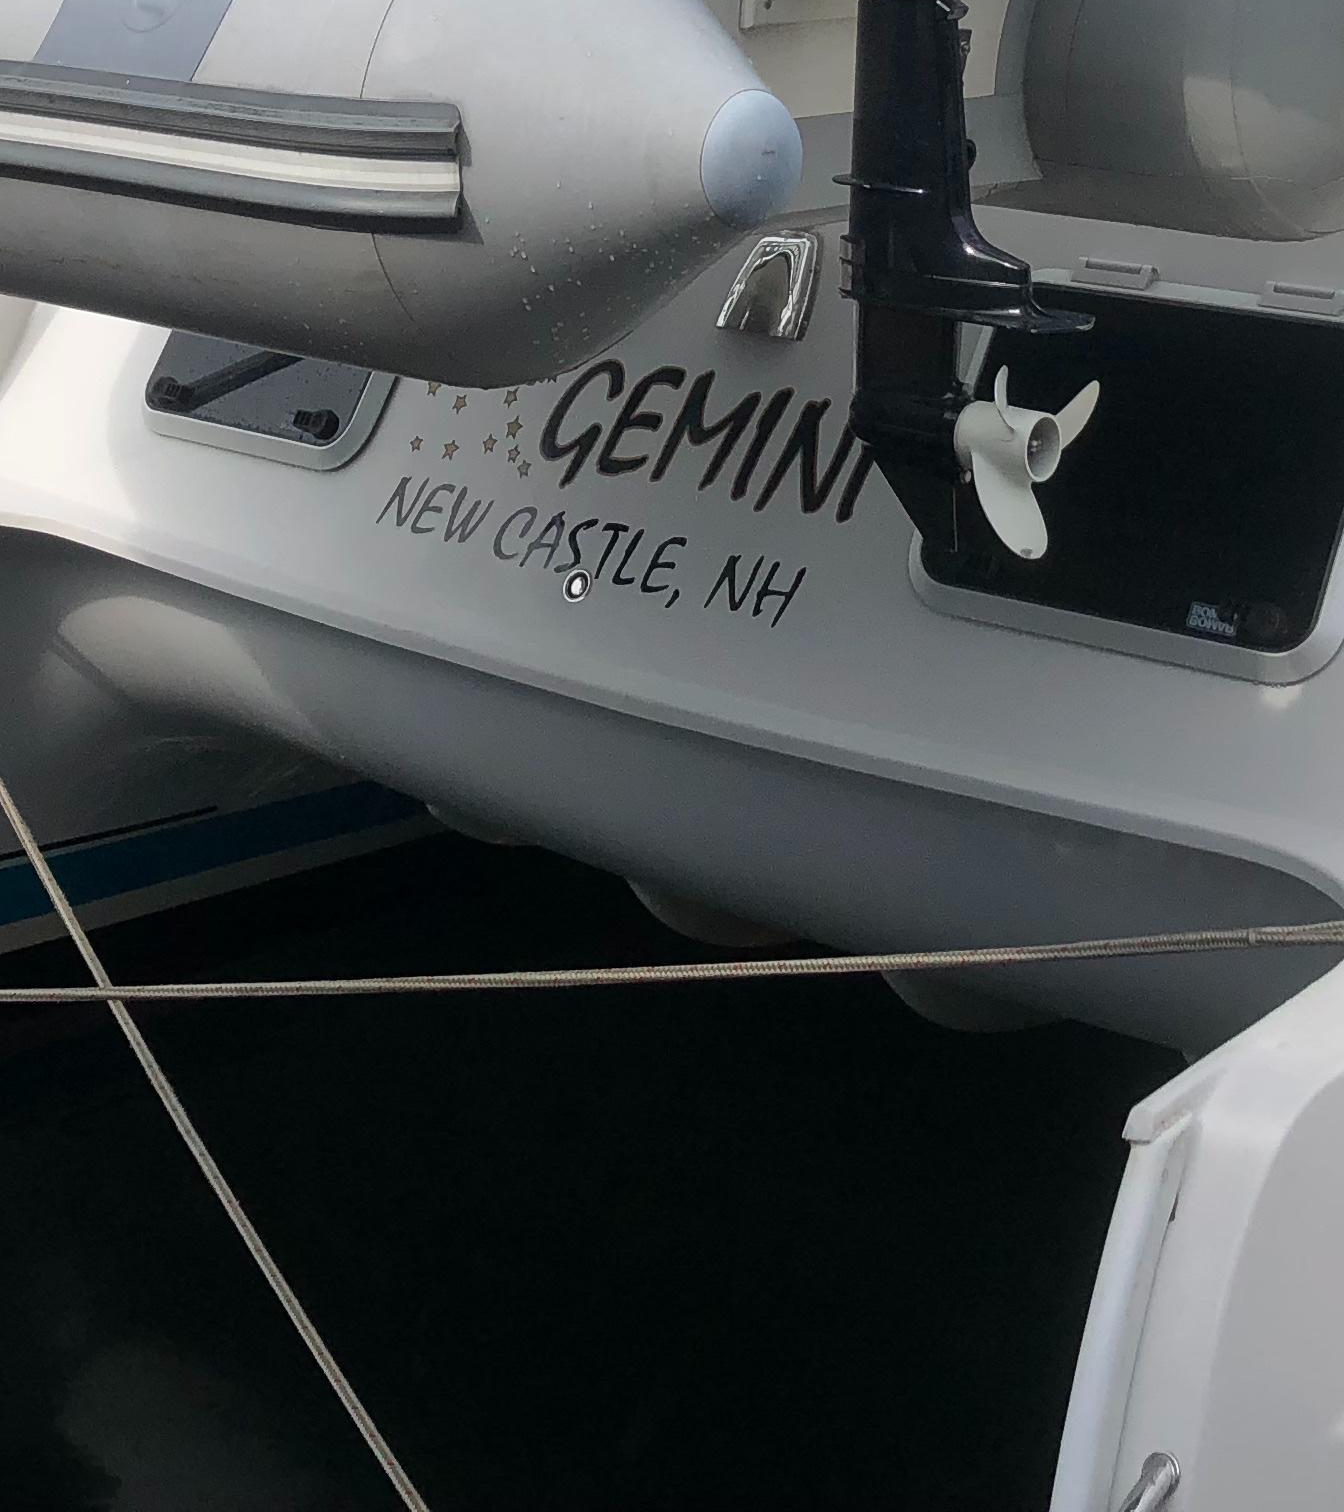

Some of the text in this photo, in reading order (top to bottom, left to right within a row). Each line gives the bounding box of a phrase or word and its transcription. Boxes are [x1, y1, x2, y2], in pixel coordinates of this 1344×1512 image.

[375, 476, 807, 628] NEW CASTLE, NH
